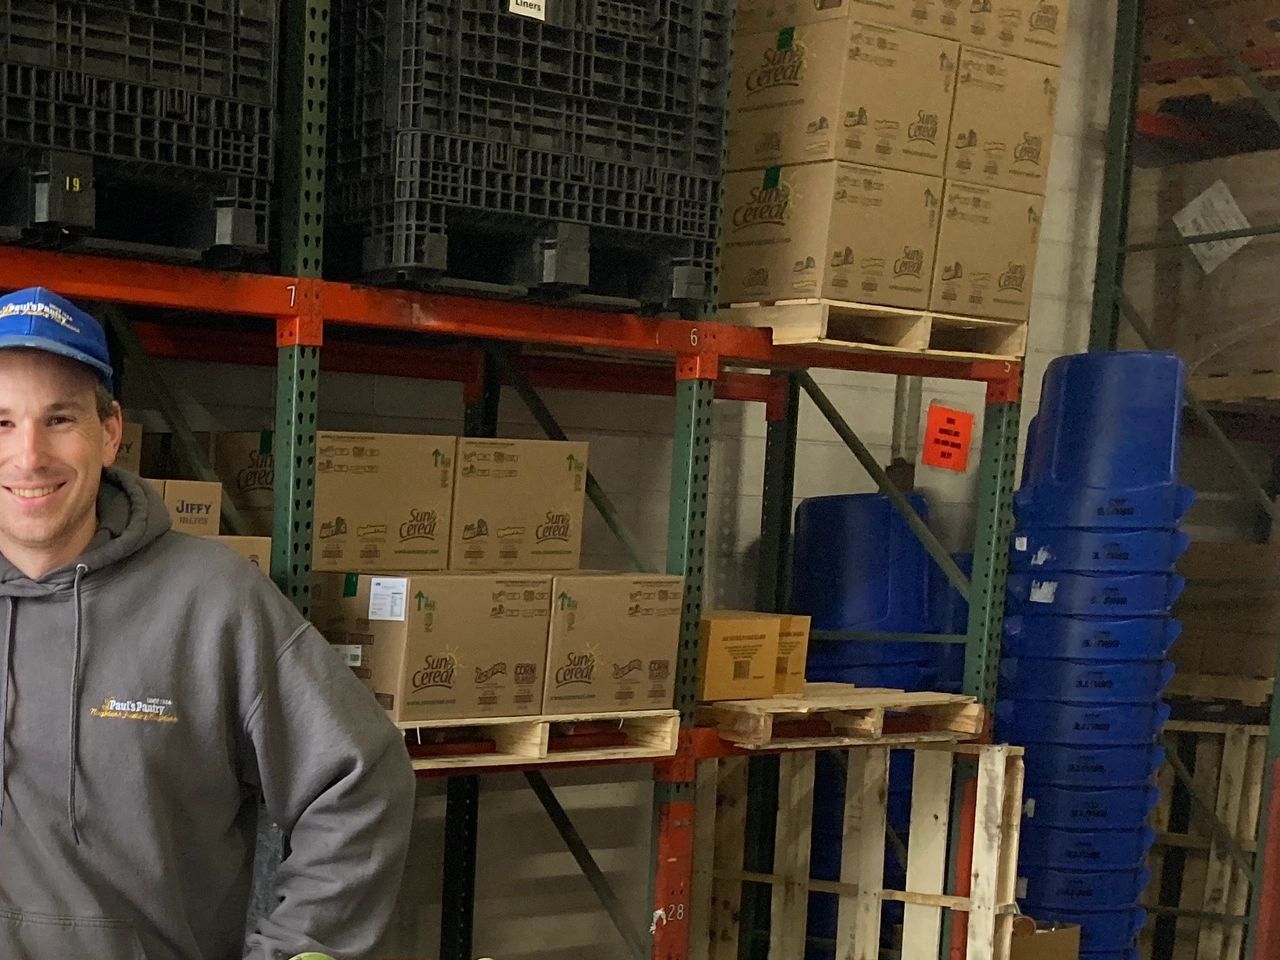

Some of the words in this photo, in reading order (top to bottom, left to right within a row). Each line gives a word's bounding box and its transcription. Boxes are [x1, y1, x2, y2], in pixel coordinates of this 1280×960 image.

[745, 61, 803, 92] Cereal
[732, 202, 788, 229] Cereal
[287, 284, 297, 307] 7
[689, 327, 699, 347] 6
[175, 500, 212, 515] JIFFY
[399, 520, 437, 539] Cereal
[536, 523, 570, 540] Cereal
[423, 654, 449, 670] Sun
[566, 652, 589, 667] Sun
[412, 668, 455, 687] Cereal
[555, 664, 595, 682] Cereal
[109, 699, 136, 712] Paul's
[136, 701, 166, 716] Pantry
[667, 903, 685, 921] 28
